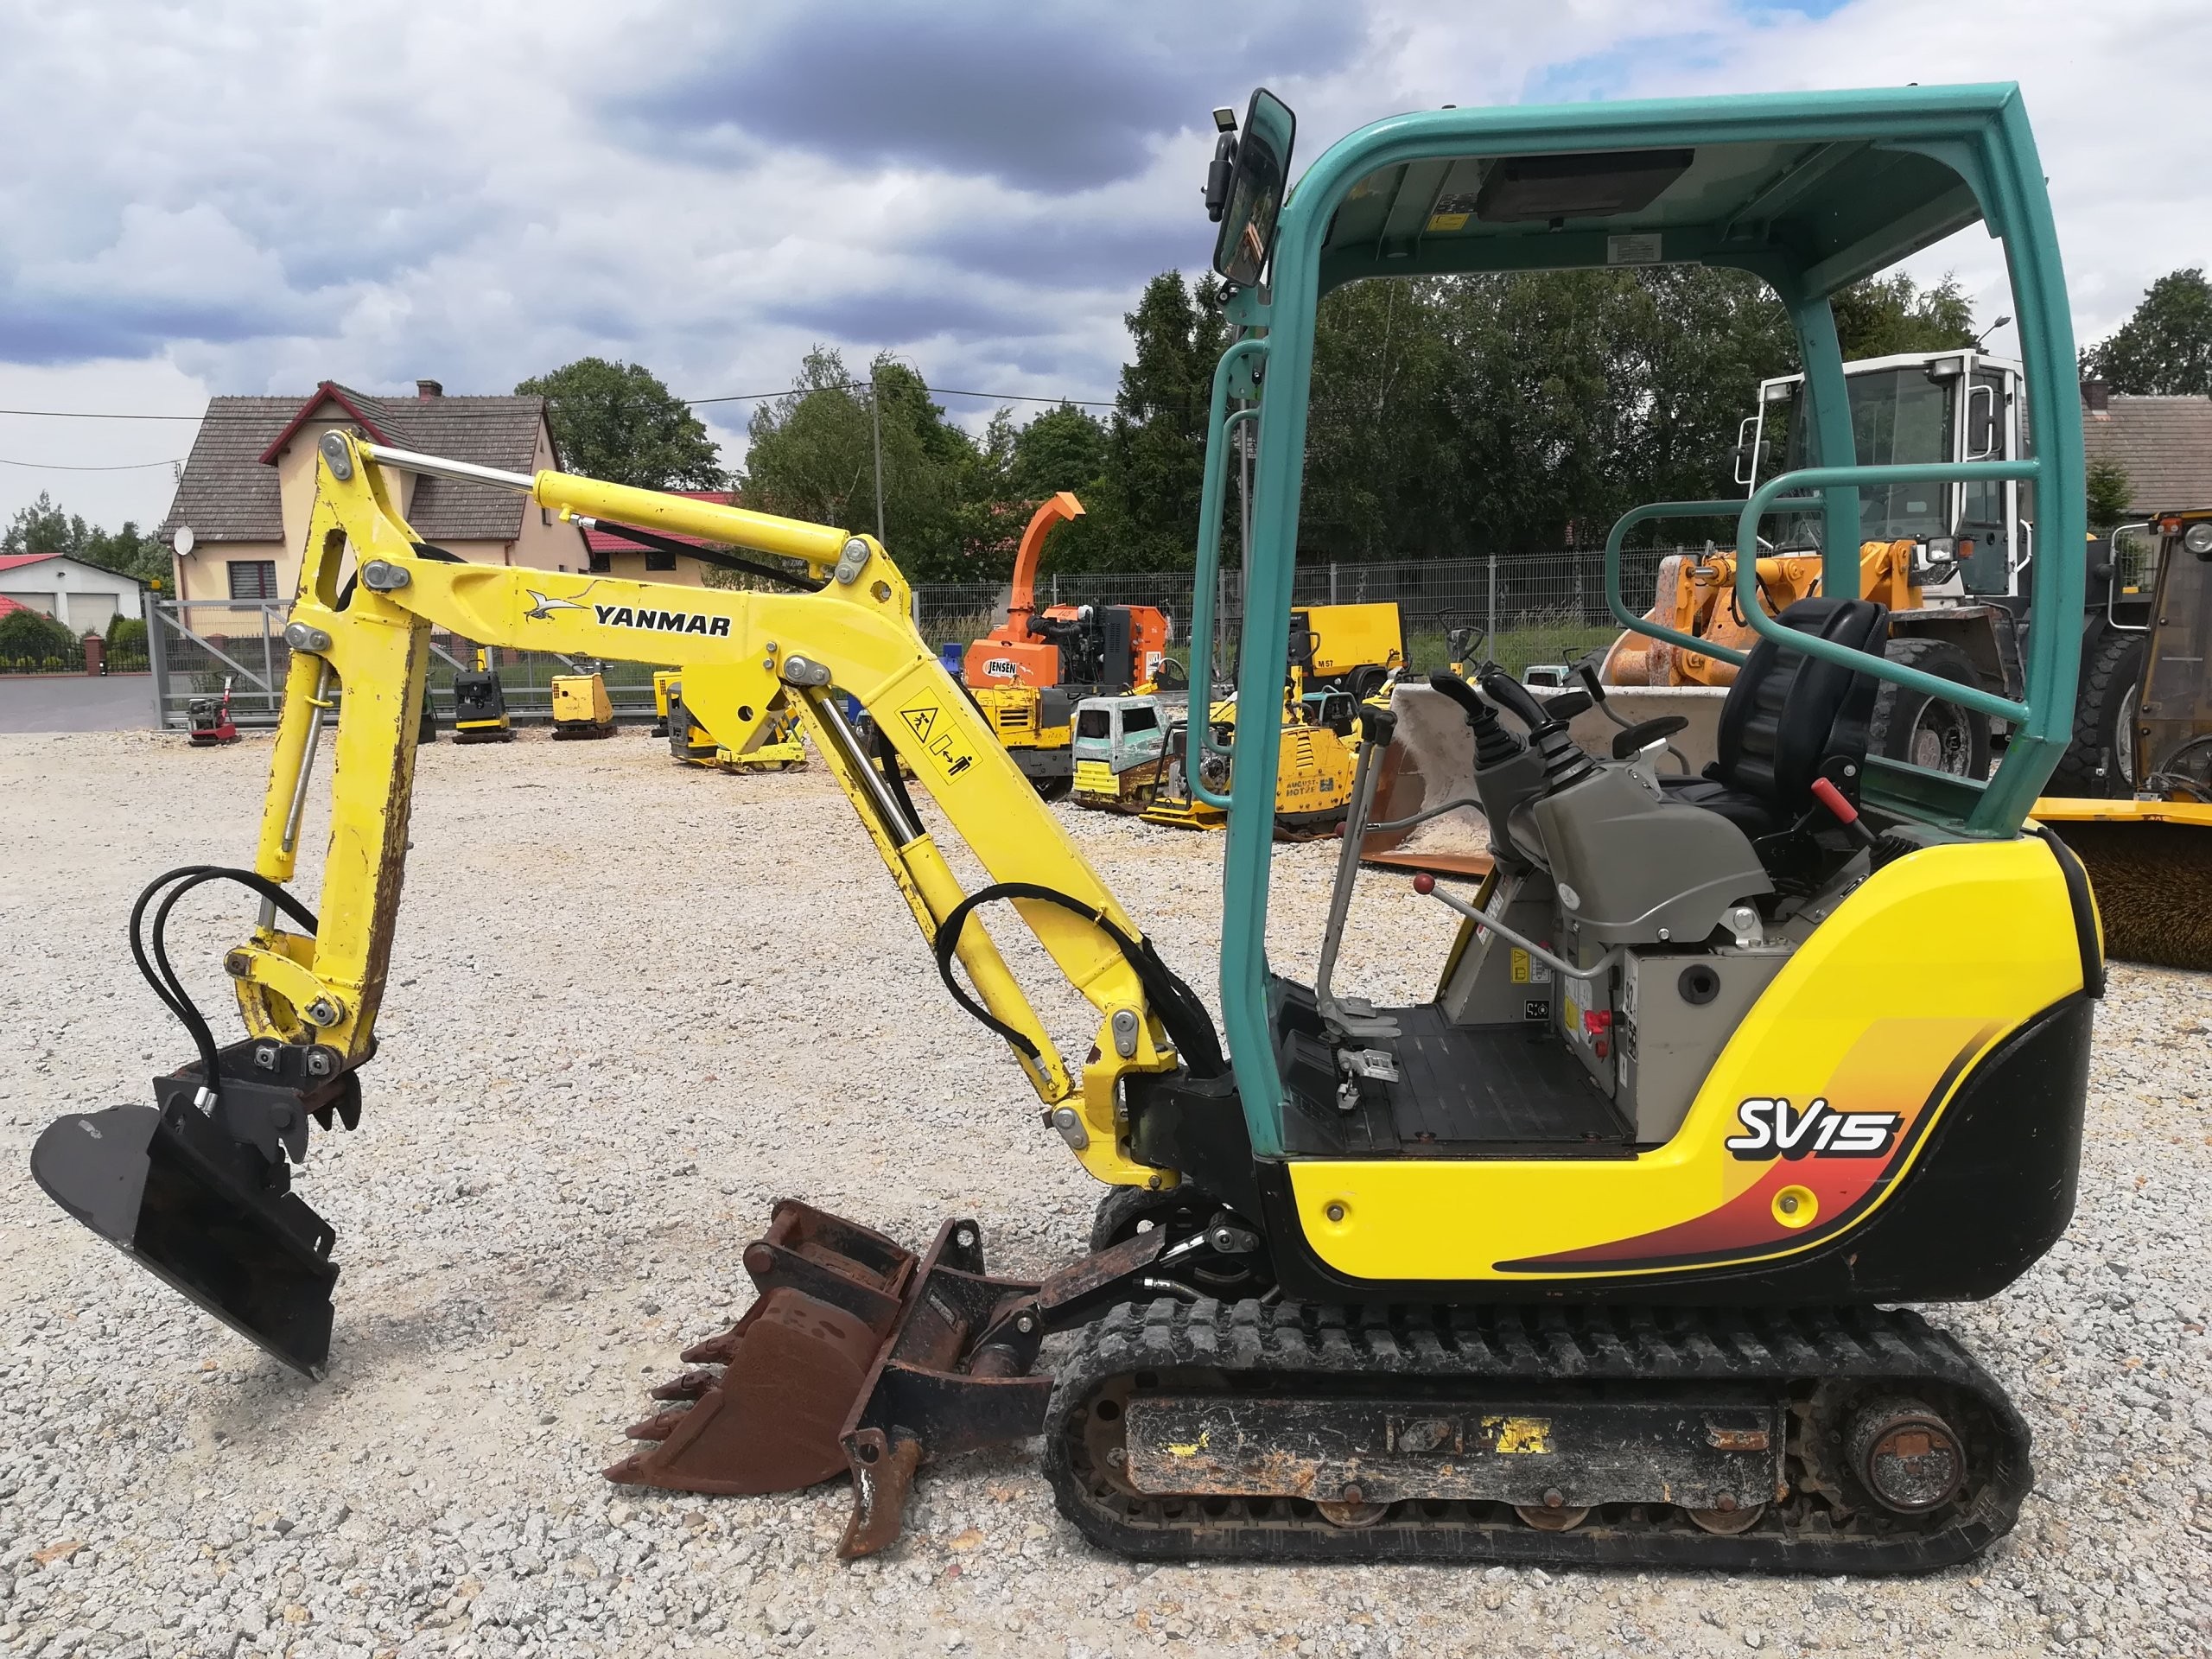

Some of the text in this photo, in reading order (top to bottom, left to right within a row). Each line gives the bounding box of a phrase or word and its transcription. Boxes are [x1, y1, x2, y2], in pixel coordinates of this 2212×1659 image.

[594, 605, 731, 637] YANMAR
[988, 661, 1016, 674] JENSEN
[1726, 1098, 1899, 1156] SV15
